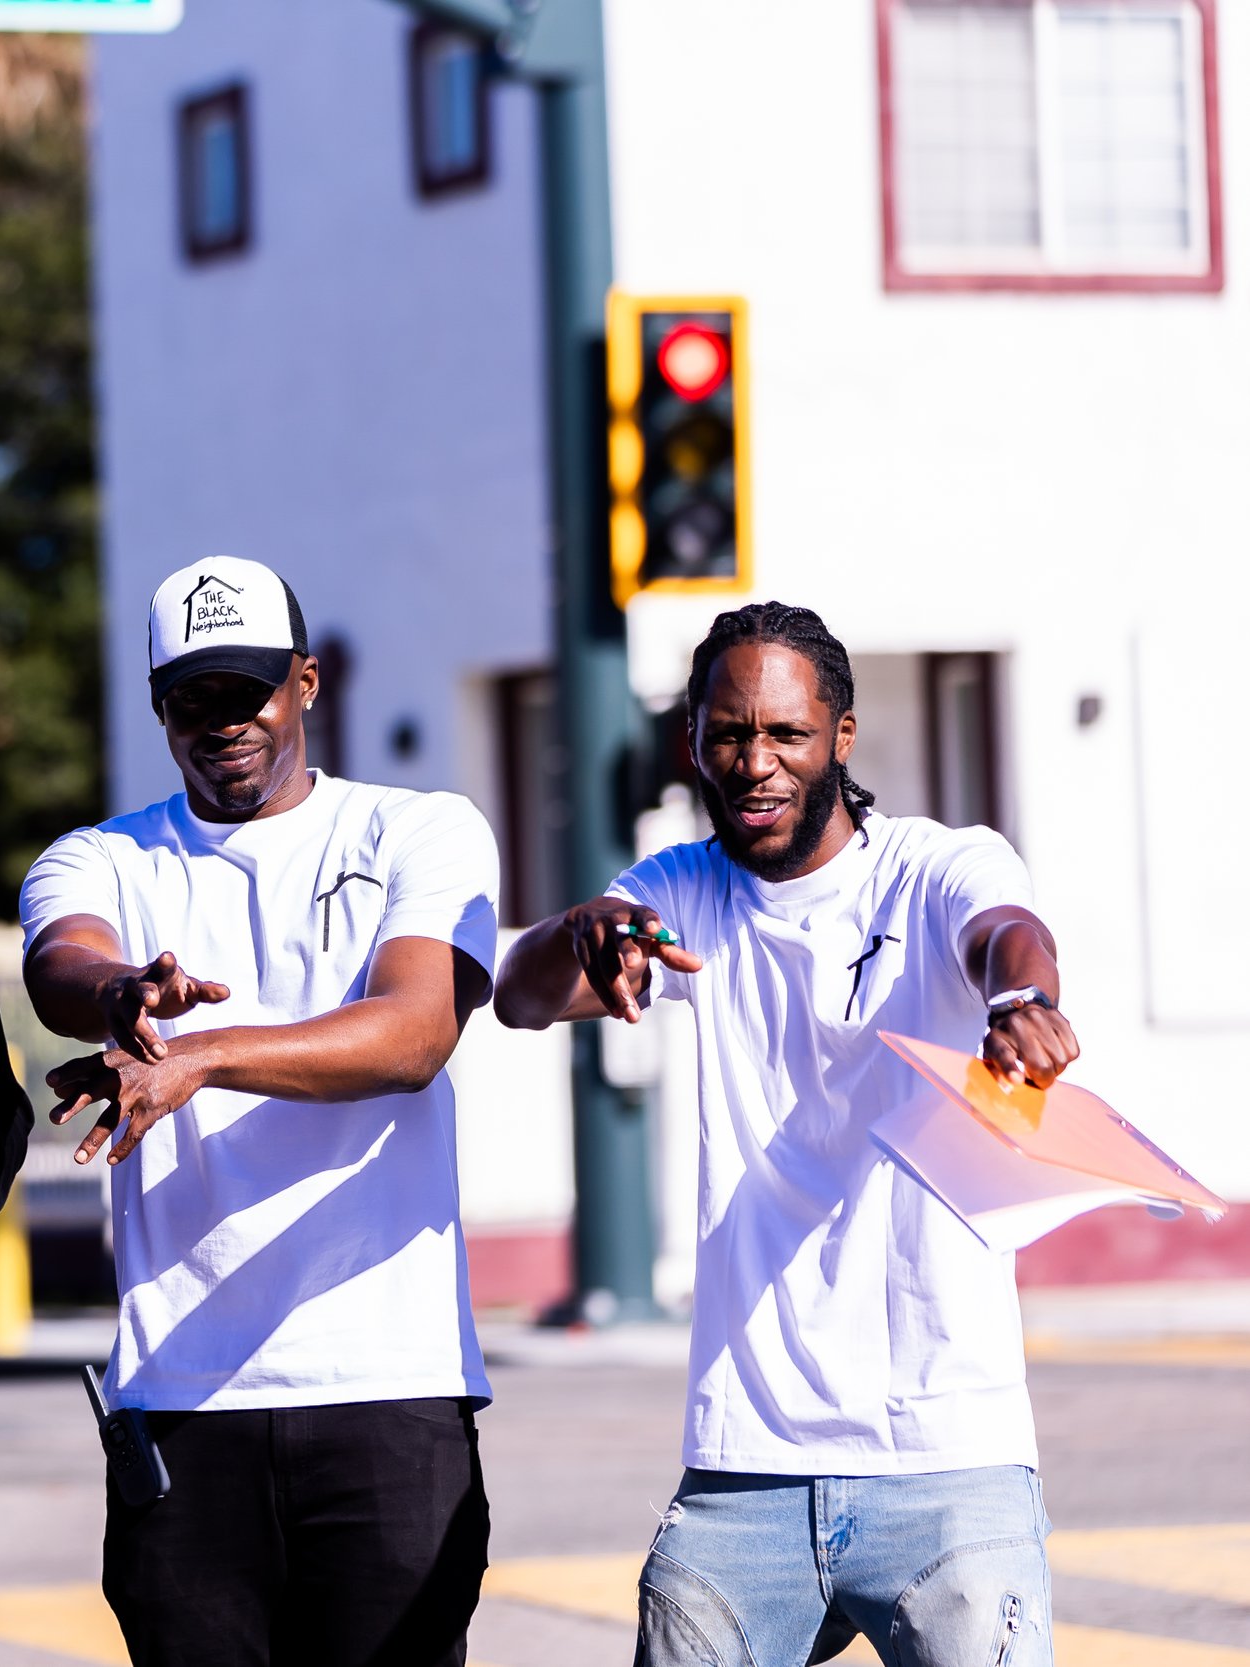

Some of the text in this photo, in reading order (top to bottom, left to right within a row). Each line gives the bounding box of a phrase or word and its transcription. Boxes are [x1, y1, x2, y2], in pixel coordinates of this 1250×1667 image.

[199, 590, 226, 604] THE
[197, 605, 238, 620] BLACK
[192, 617, 244, 634] Neighborhood
